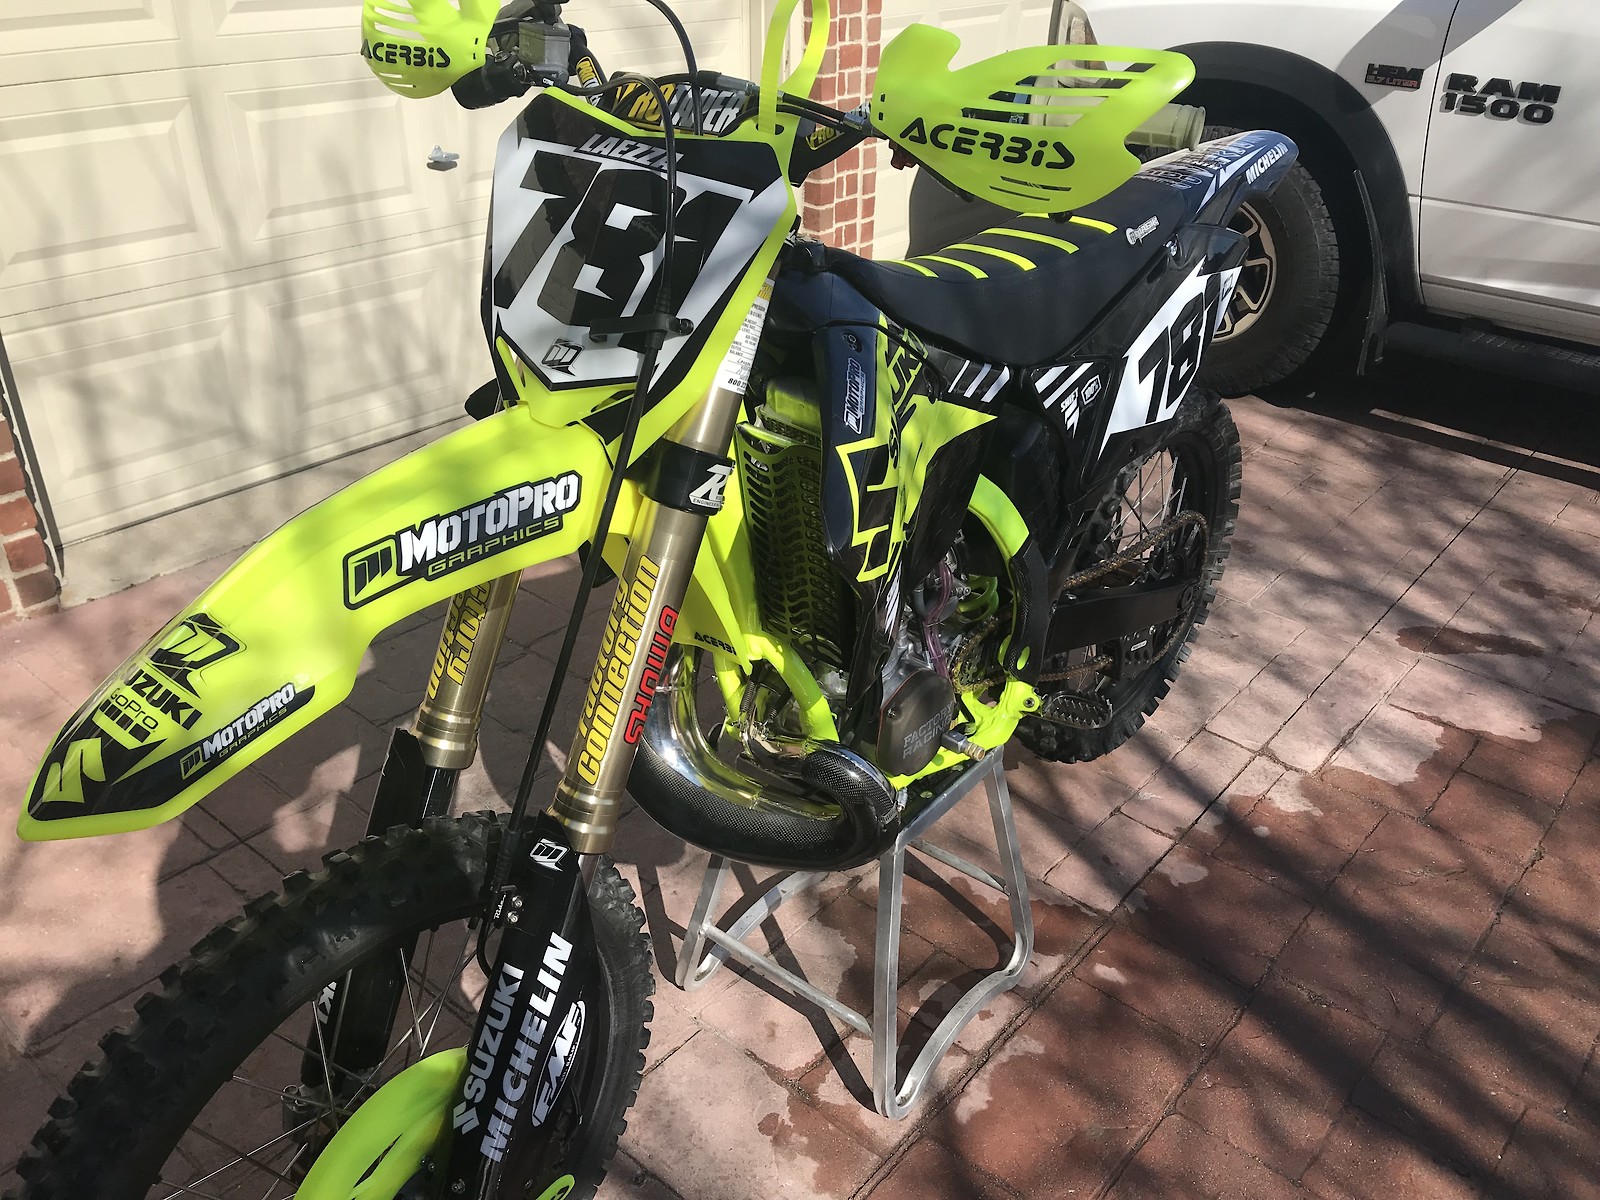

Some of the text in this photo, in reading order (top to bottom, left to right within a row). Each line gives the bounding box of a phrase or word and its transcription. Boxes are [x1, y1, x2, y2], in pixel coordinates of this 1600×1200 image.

[1444, 92, 1554, 124] 1500
[1448, 72, 1562, 104] RAM
[1245, 141, 1289, 185] MICHELIN
[1060, 387, 1079, 413] SHIFT
[400, 472, 581, 574] MOTOPRO
[427, 515, 561, 576] GRAPHICS
[577, 554, 660, 786] connection
[624, 605, 679, 745] SHOWA
[110, 687, 159, 730] GoPro
[202, 683, 296, 761] MOTOPRO
[219, 707, 288, 759] GRAPHICS
[903, 702, 954, 748] FACTORY
[903, 712, 952, 760] RACING
[464, 962, 525, 1103] SUZUKI
[480, 931, 574, 1164] MICHELIN
